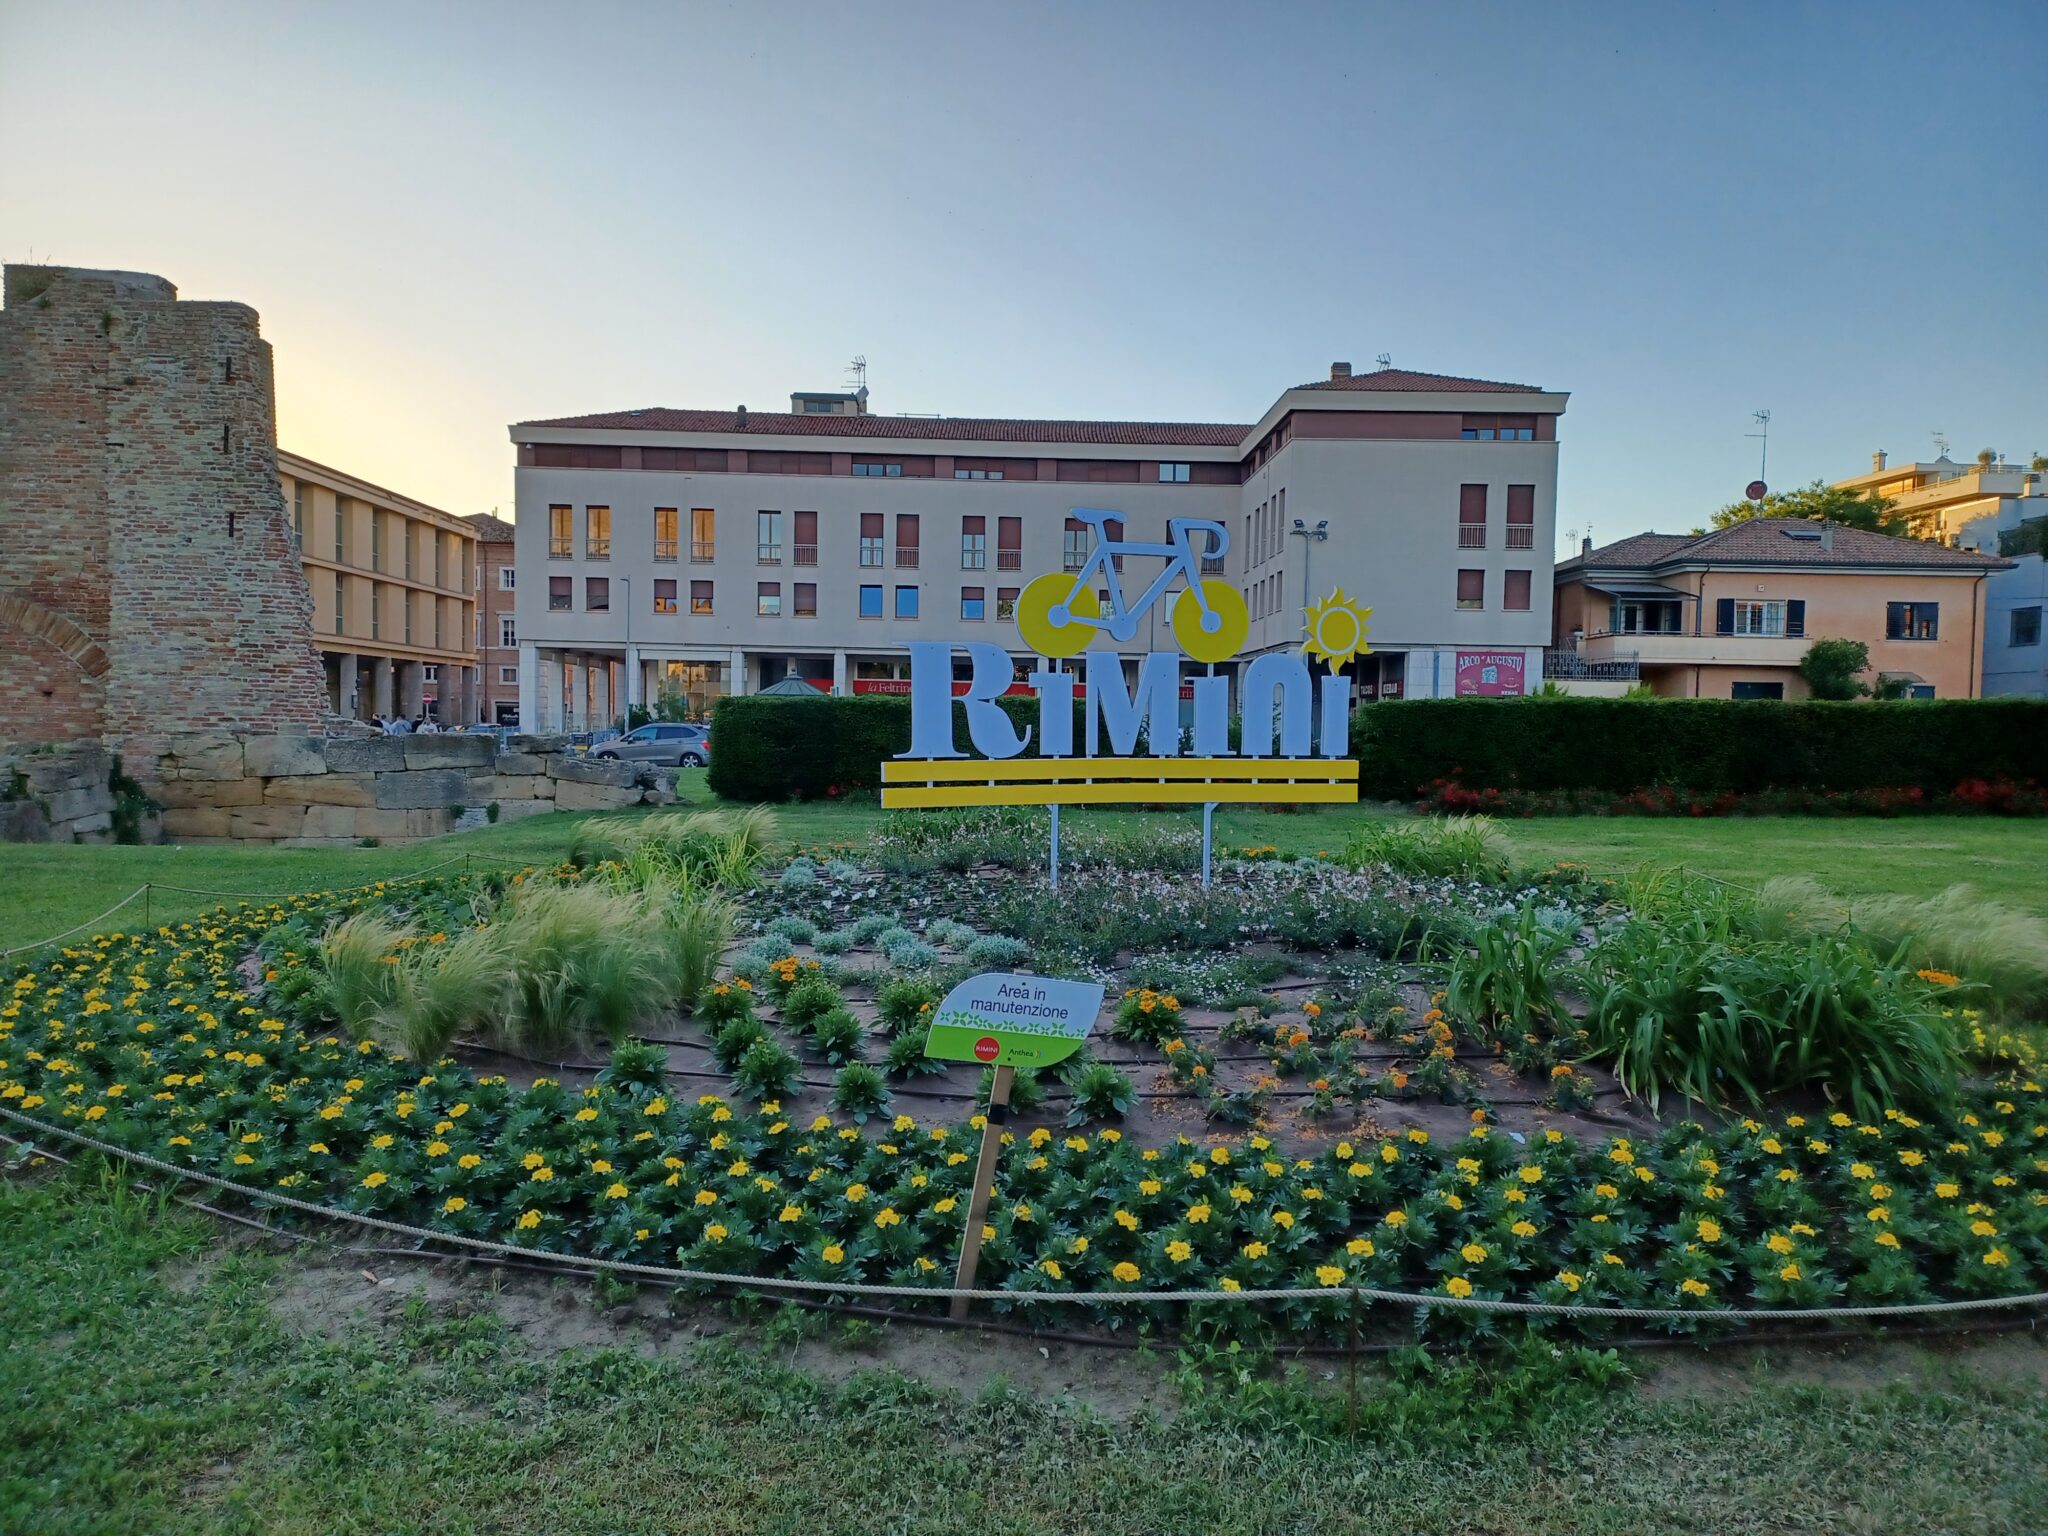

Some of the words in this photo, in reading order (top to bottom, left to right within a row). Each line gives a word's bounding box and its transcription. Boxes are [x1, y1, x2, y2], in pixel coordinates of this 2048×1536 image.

[1459, 655, 1480, 673] ARCO
[997, 983, 1030, 1000] Area
[1034, 986, 1046, 1001] in
[970, 998, 1069, 1020] manutenzione
[975, 1045, 998, 1054] RIMINI
[1008, 1048, 1034, 1057] Anthea
